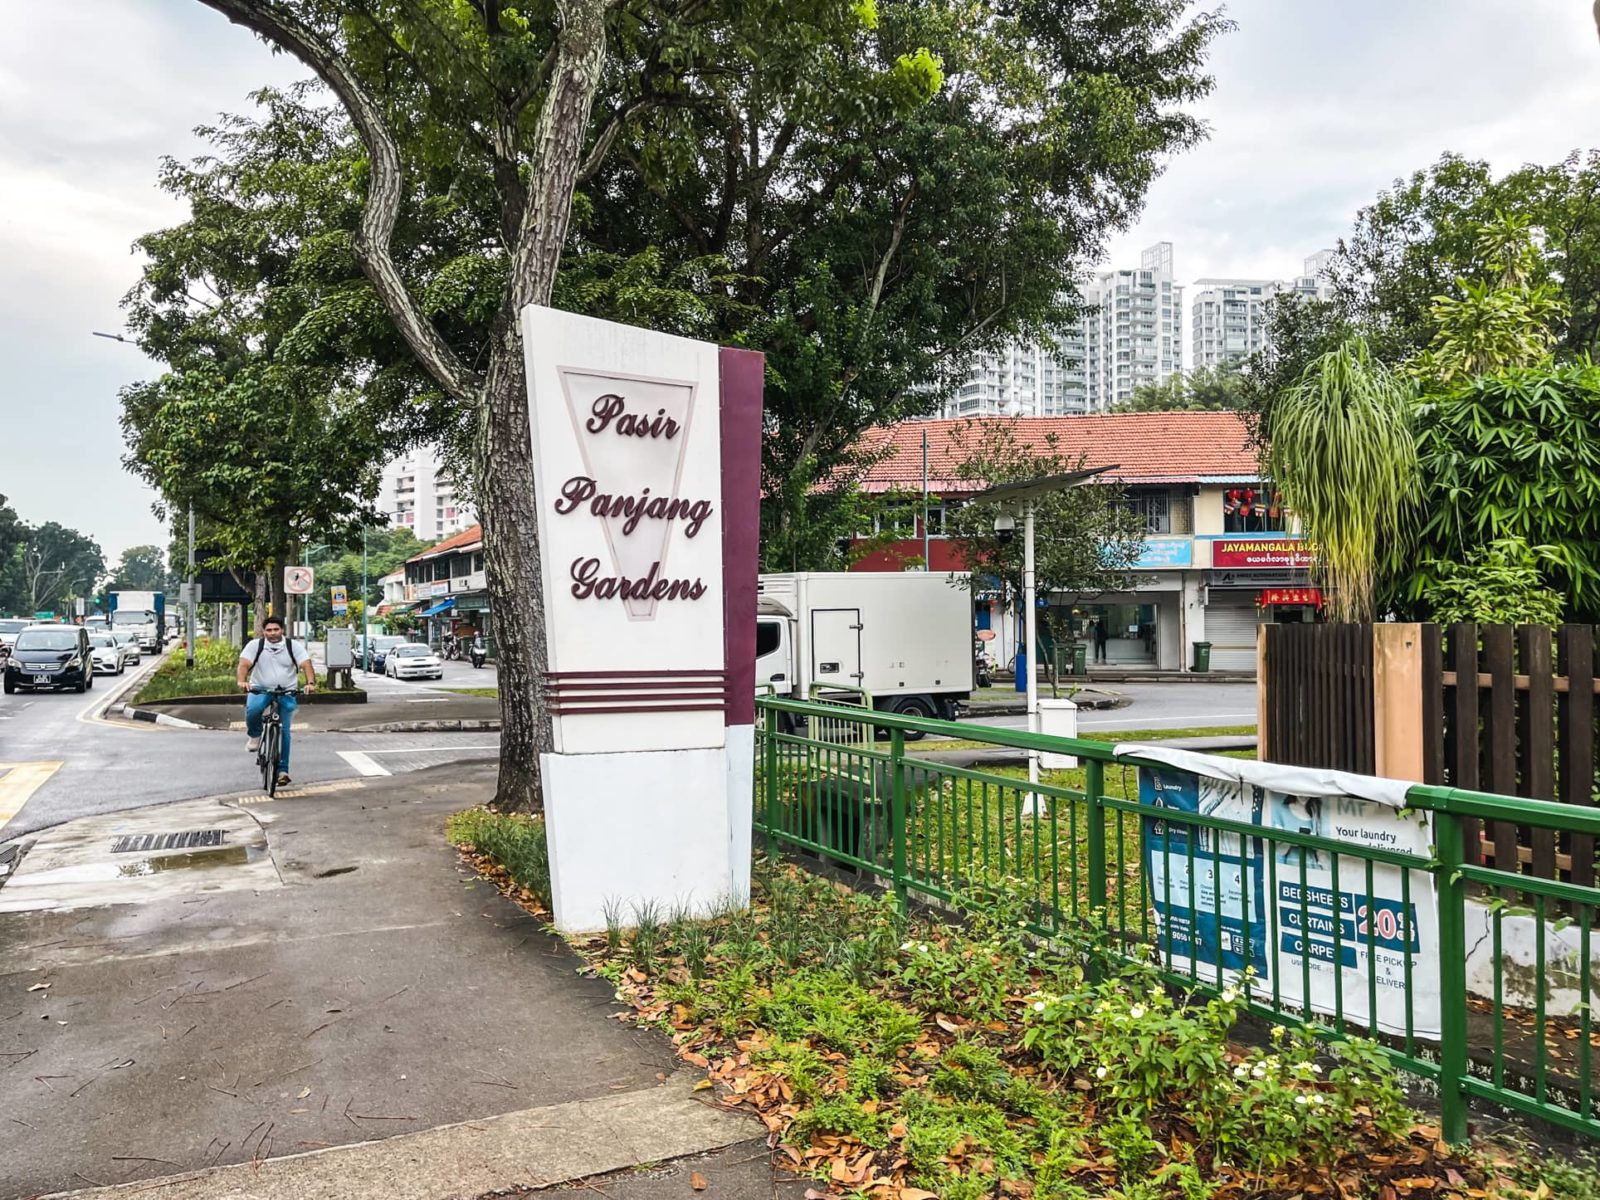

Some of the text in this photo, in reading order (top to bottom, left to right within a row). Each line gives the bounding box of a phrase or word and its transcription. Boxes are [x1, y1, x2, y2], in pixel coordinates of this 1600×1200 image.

[586, 393, 681, 440] Pasir
[554, 475, 713, 539] Panjang
[1221, 543, 1296, 552] JAYAMANGALA
[570, 556, 708, 601] Gardens
[1336, 826, 1397, 844] Your laundry
[1208, 869, 1214, 879] 3
[1234, 874, 1241, 884] 4
[1282, 886, 1349, 909] BEDSHEES
[1294, 940, 1335, 960] CRPE
[1360, 951, 1382, 963] FE
[1383, 955, 1403, 968] PICK
[1376, 976, 1406, 990] ELIVER
